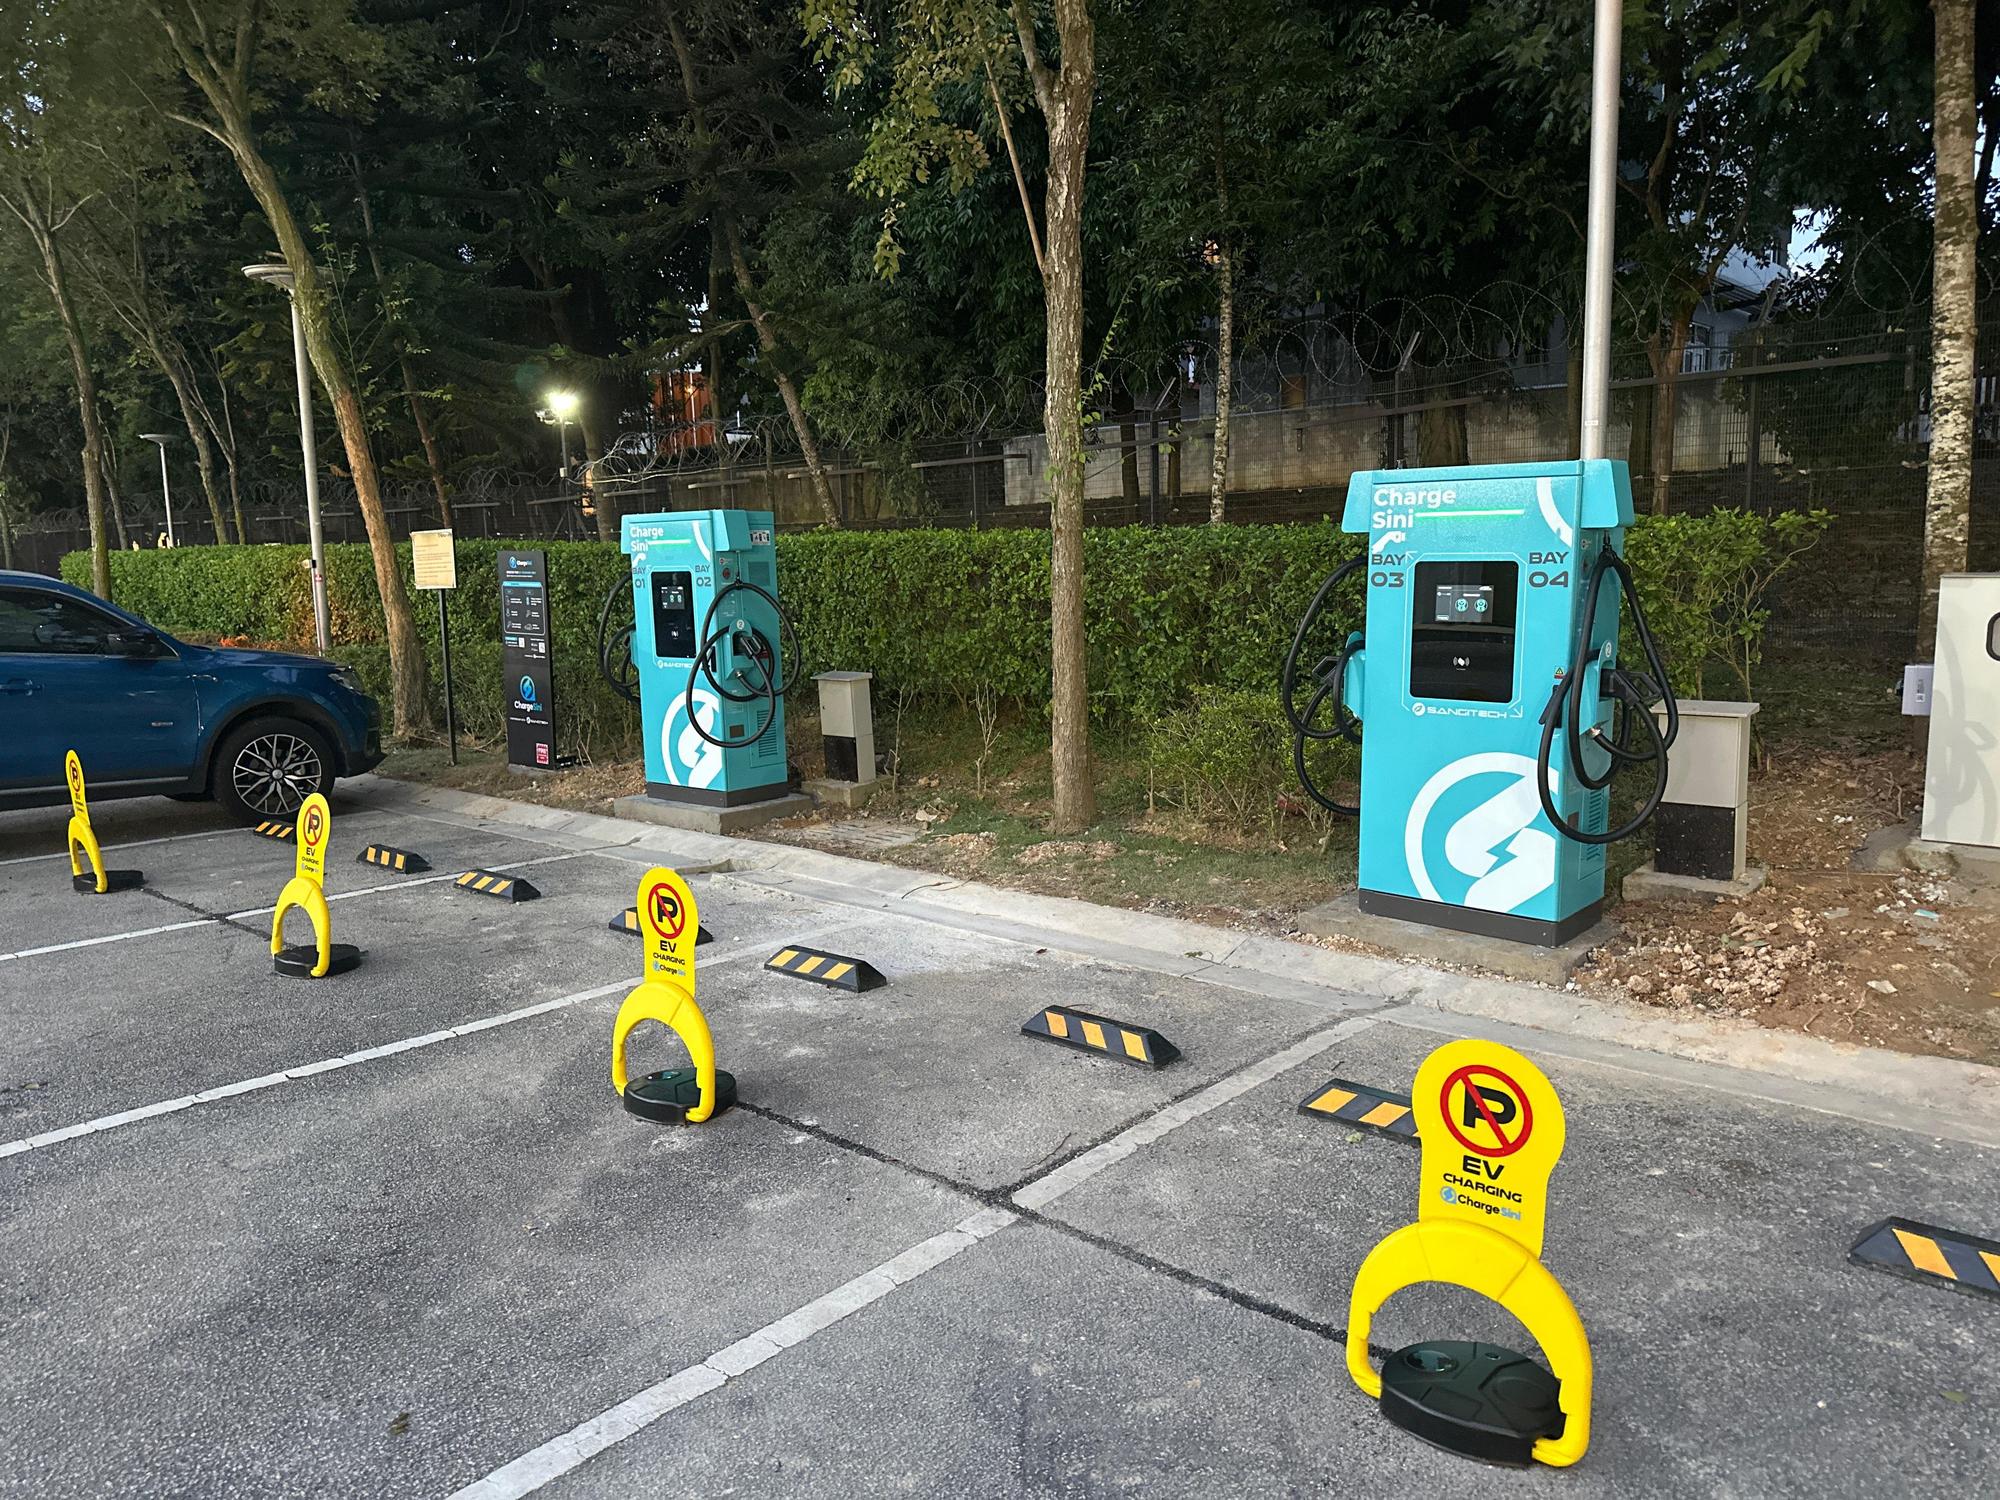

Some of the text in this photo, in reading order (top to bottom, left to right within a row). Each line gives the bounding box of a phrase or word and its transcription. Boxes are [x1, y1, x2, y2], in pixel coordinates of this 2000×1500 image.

[1373, 488, 1457, 508] Charge
[1372, 509, 1414, 529] Sini
[630, 527, 664, 538] Charge
[630, 539, 649, 551] Sini
[1371, 553, 1406, 566] BAY
[1529, 552, 1569, 564] BAY
[695, 565, 711, 573] BAY
[634, 578, 646, 588] 01
[696, 577, 712, 587] 02
[1371, 572, 1404, 588] 03
[1529, 571, 1569, 588] 04
[306, 846, 316, 857] EV
[657, 895, 678, 923] P
[660, 939, 677, 953] EV
[653, 952, 686, 966] CHARGING
[1463, 1084, 1517, 1129] P
[1462, 1155, 1505, 1180] EV
[1443, 1172, 1522, 1203] CHARGING
